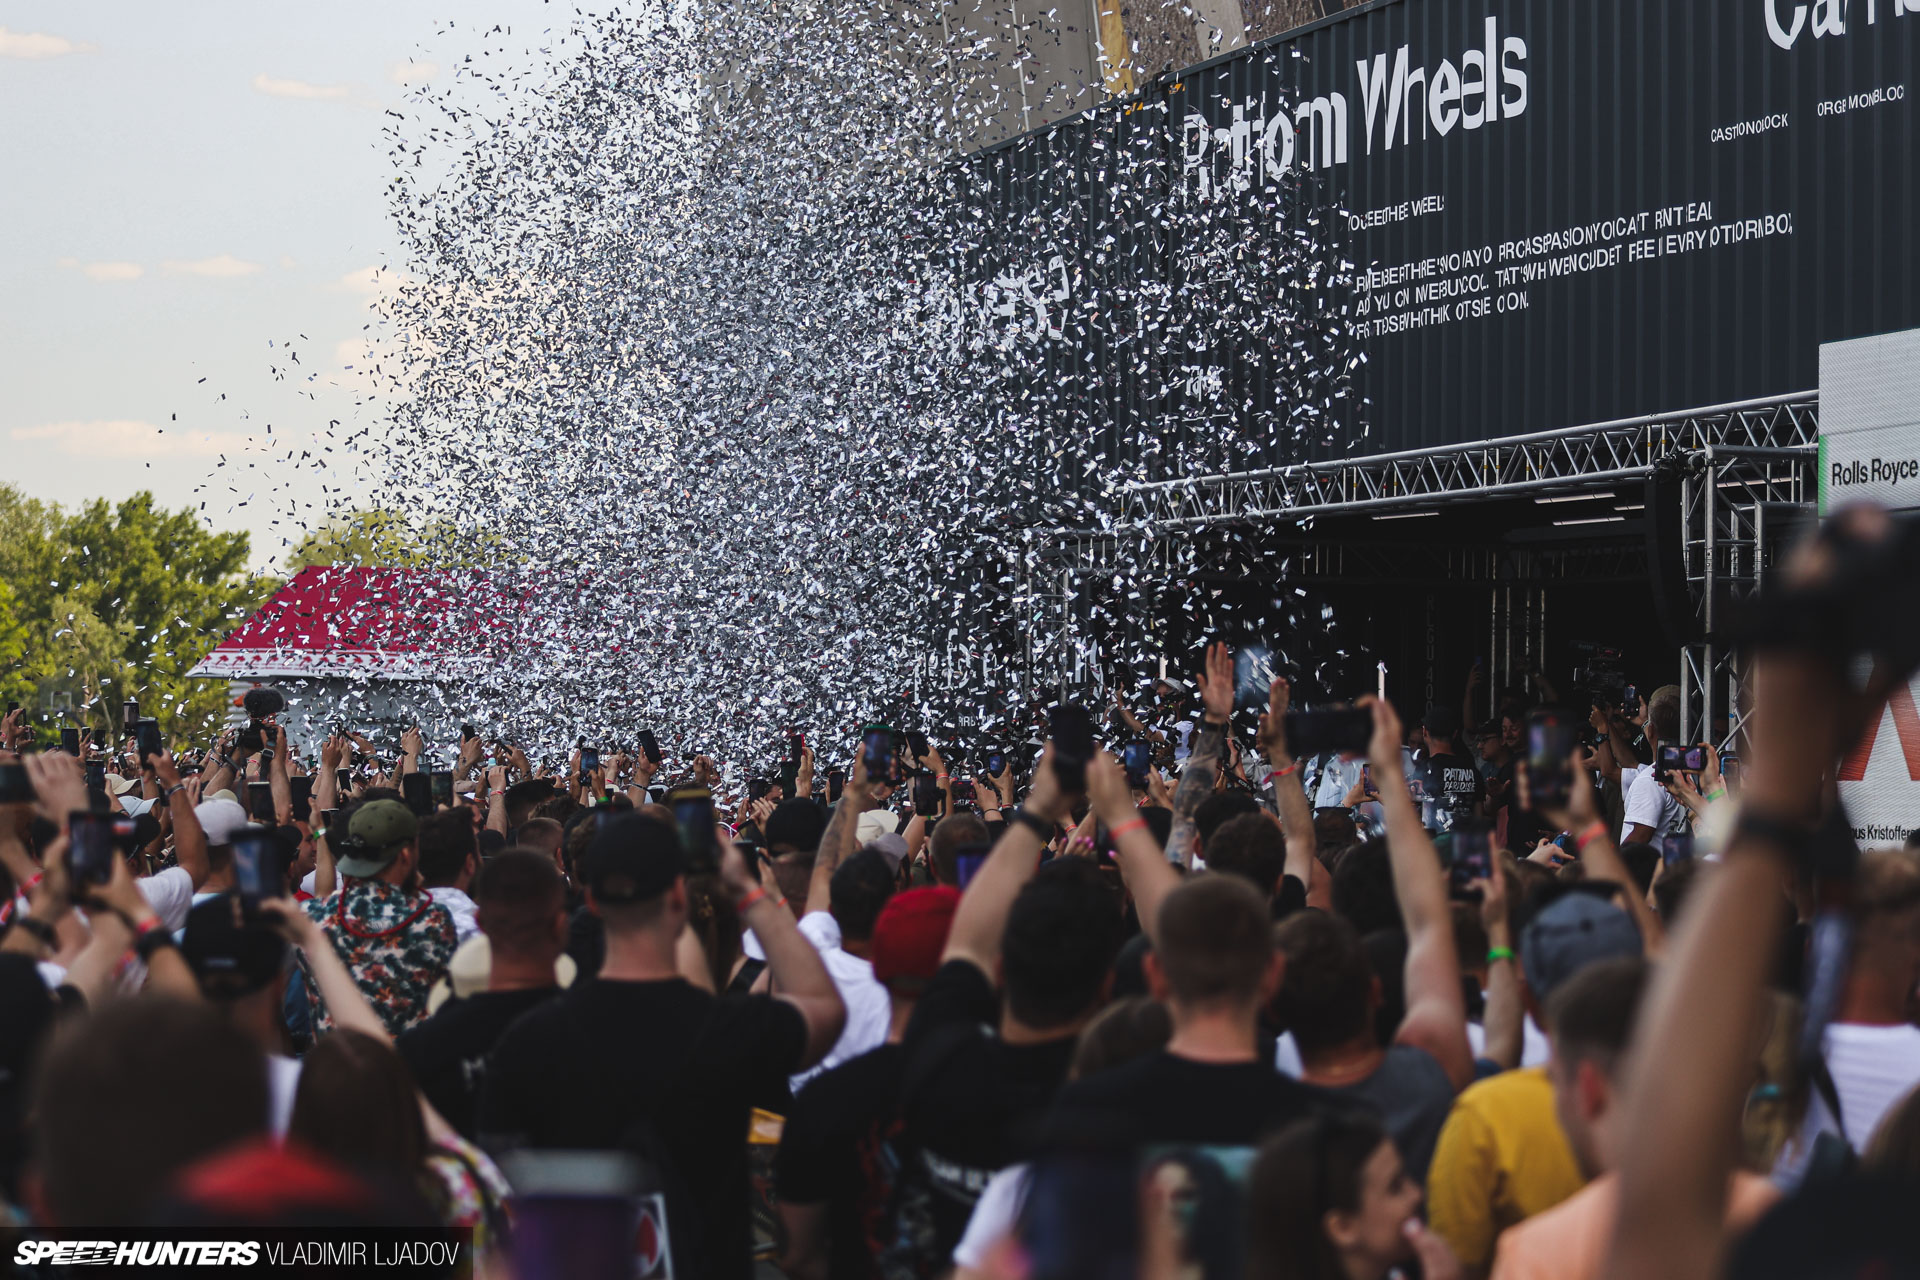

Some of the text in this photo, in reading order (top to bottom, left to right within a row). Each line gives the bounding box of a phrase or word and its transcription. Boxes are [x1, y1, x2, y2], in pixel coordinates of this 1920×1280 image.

[1356, 16, 1527, 155] Wheels
[1832, 458, 1919, 486] Rolls Royce
[1443, 768, 1475, 781] PATINA
